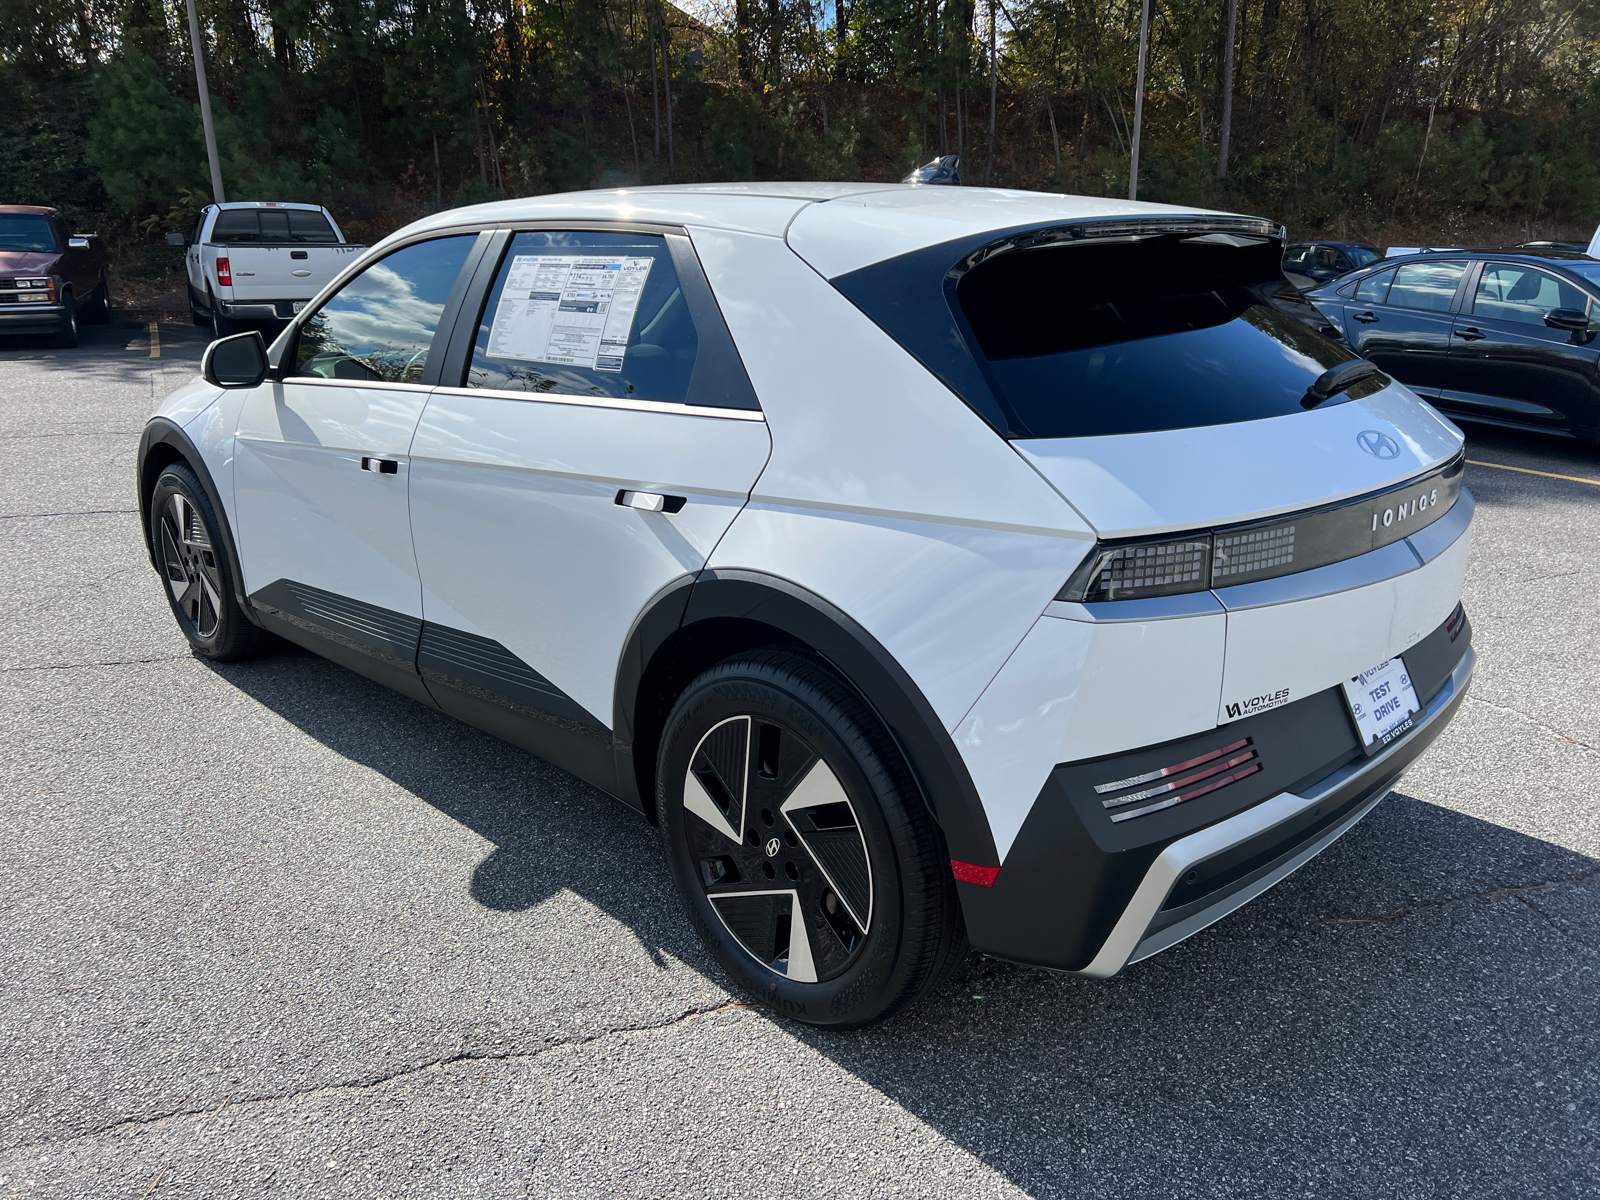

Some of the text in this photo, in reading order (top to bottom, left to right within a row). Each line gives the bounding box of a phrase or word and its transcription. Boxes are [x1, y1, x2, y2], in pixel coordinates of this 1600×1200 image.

[1363, 660, 1389, 678] VOYLES
[1243, 688, 1290, 708] VOYLES
[1368, 681, 1391, 702] TEST
[1243, 697, 1289, 715] AUTOMOTIVE
[1373, 696, 1401, 722] DRIVE
[1382, 731, 1391, 744] ED
[1391, 719, 1413, 737] VOYLES
[743, 977, 808, 1015] KUMHO
